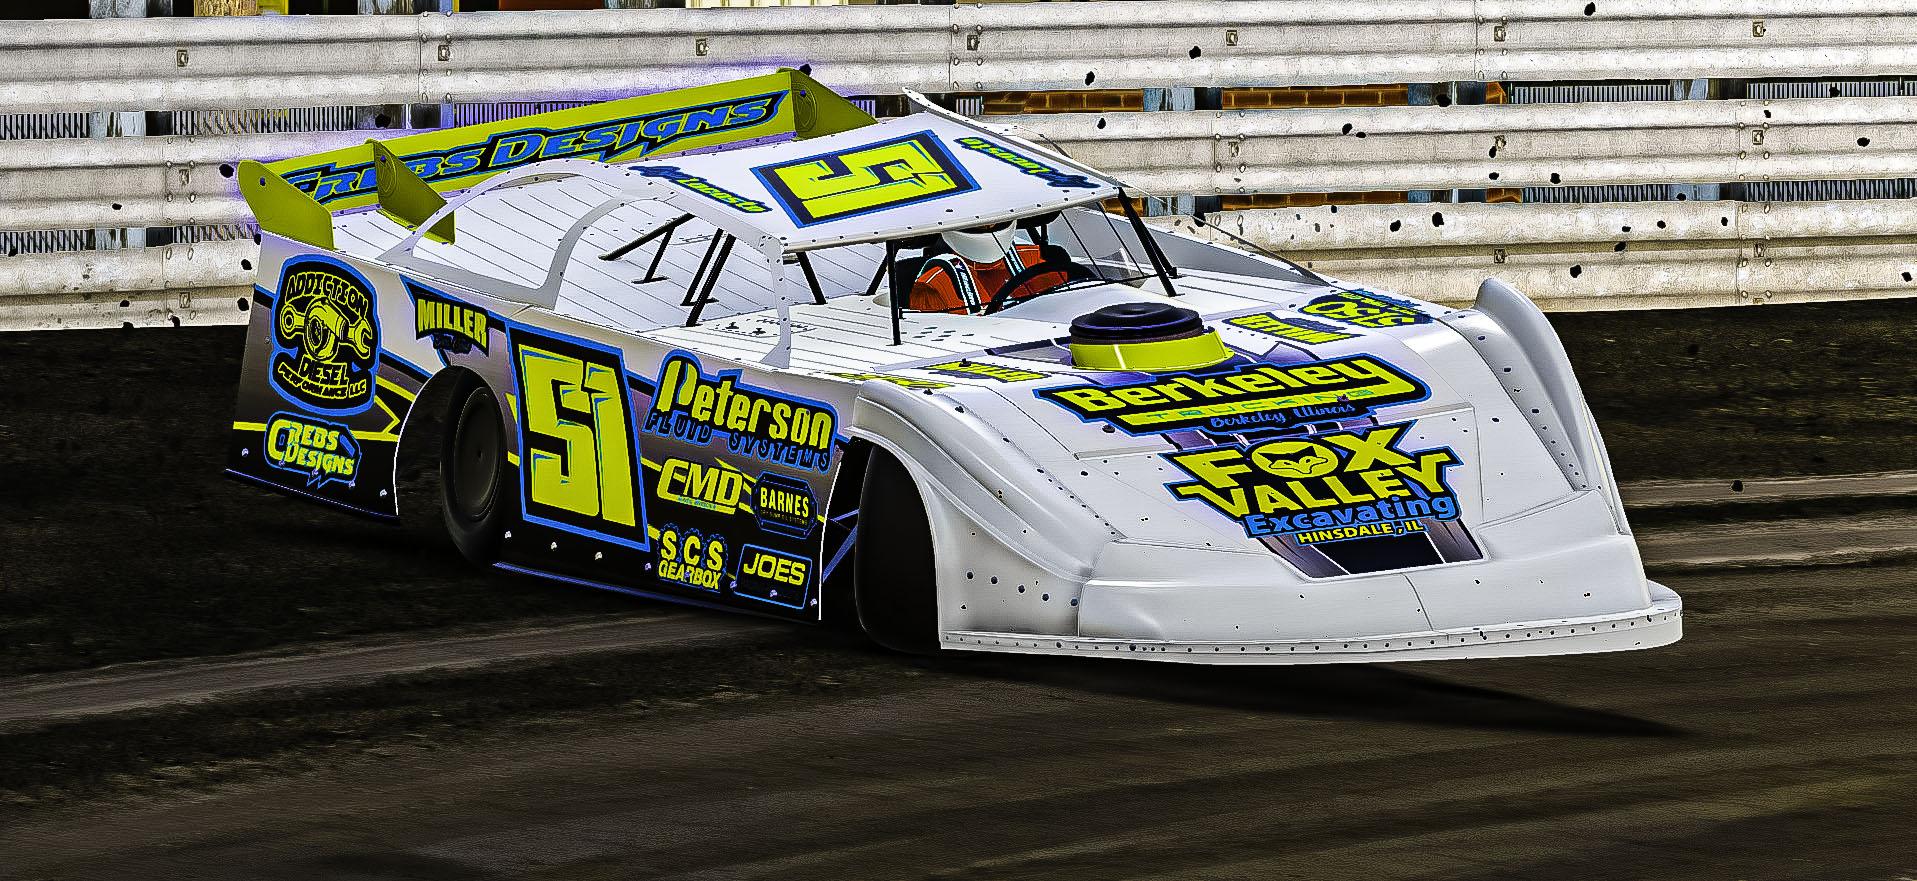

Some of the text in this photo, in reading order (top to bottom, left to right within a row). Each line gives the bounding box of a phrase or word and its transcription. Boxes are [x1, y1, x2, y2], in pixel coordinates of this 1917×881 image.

[488, 98, 773, 168] DESIGNS
[773, 139, 959, 220] 51
[285, 271, 369, 320] ADDICTION
[417, 298, 487, 349] MILLER
[298, 354, 349, 388] DIESEL
[348, 379, 367, 398] LLC
[1053, 358, 1416, 412] Berkeley
[656, 360, 832, 450] Peterson
[1146, 389, 1374, 419] TRUCKING
[268, 419, 340, 460] CREBS
[284, 443, 355, 476] DESIGNS
[518, 343, 637, 527] 51
[645, 410, 833, 474] FLUID SYSTEMS
[1174, 427, 1416, 489] FOX
[760, 487, 809, 518] BARNES
[1178, 452, 1452, 518] VALLEY
[1249, 496, 1459, 535] Excavating
[658, 560, 722, 590] GEARBOX
[743, 552, 806, 586] JOES
